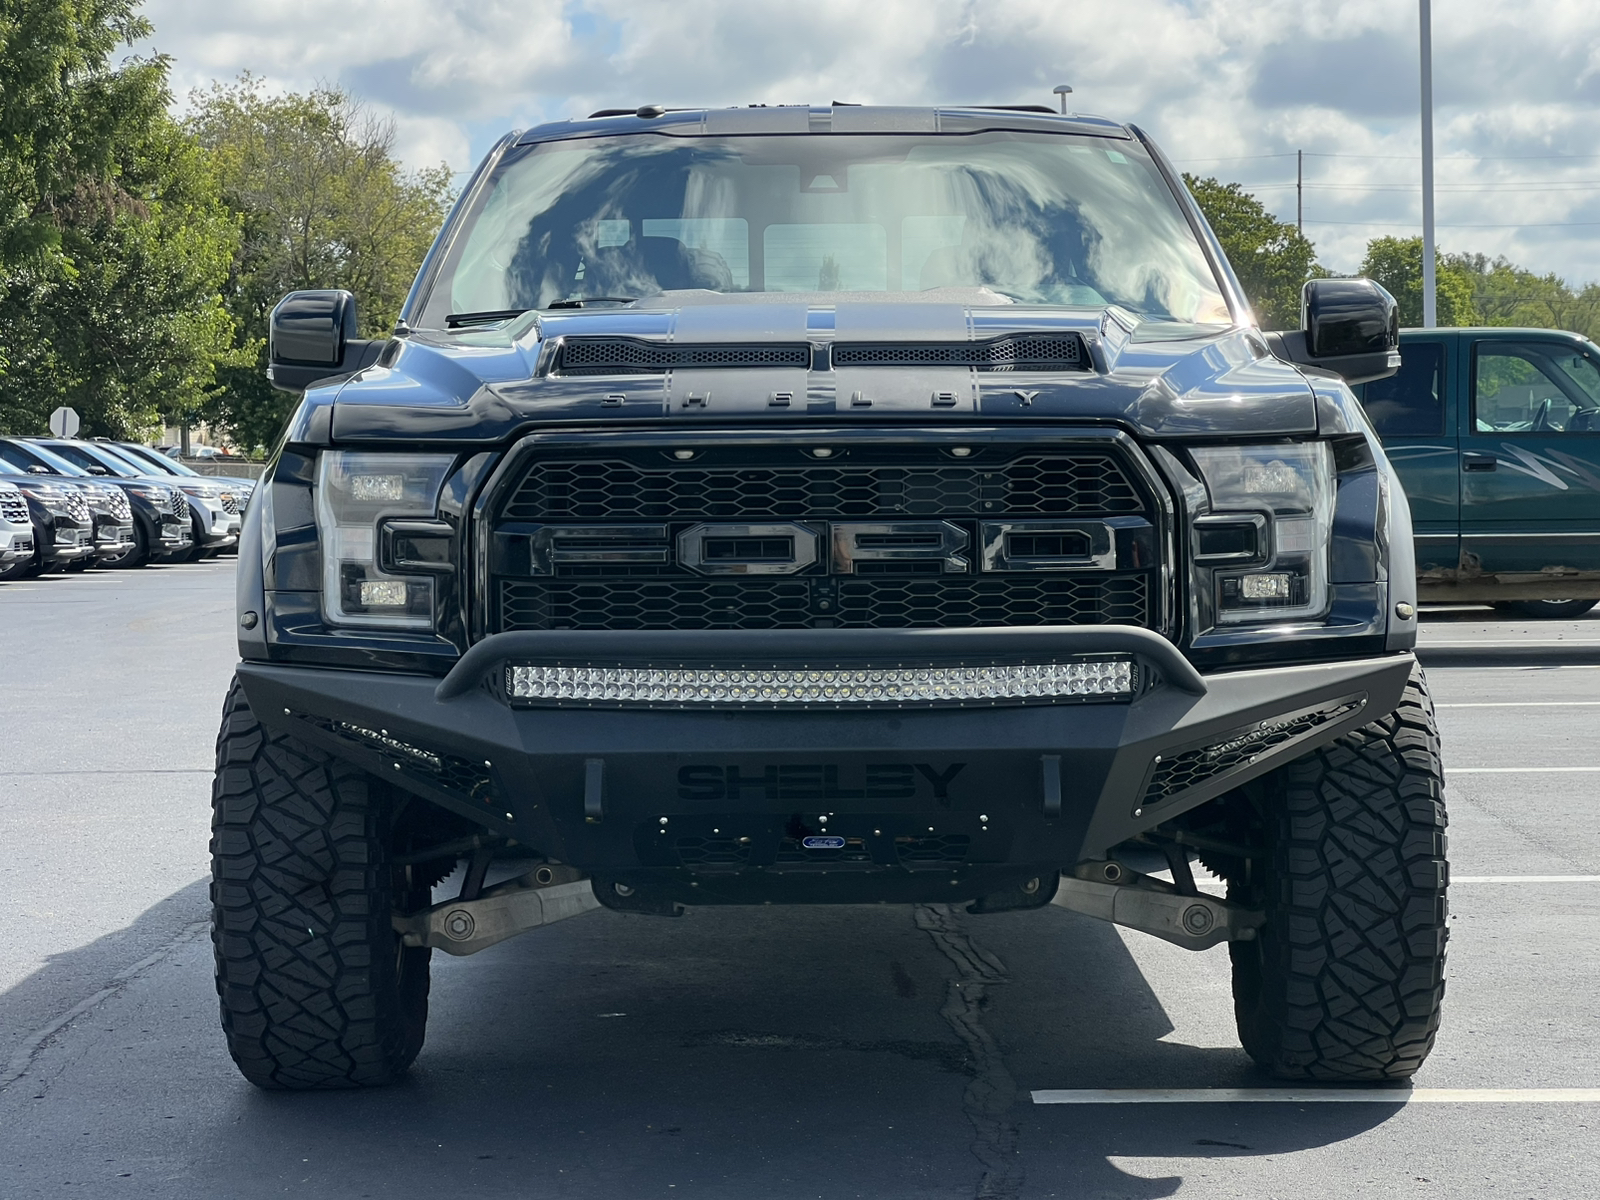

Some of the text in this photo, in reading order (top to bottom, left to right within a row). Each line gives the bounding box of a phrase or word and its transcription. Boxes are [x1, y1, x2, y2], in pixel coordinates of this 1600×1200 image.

[601, 390, 1040, 408] SHELBY
[528, 521, 1117, 576] FORD
[677, 763, 967, 800] SHELBY
